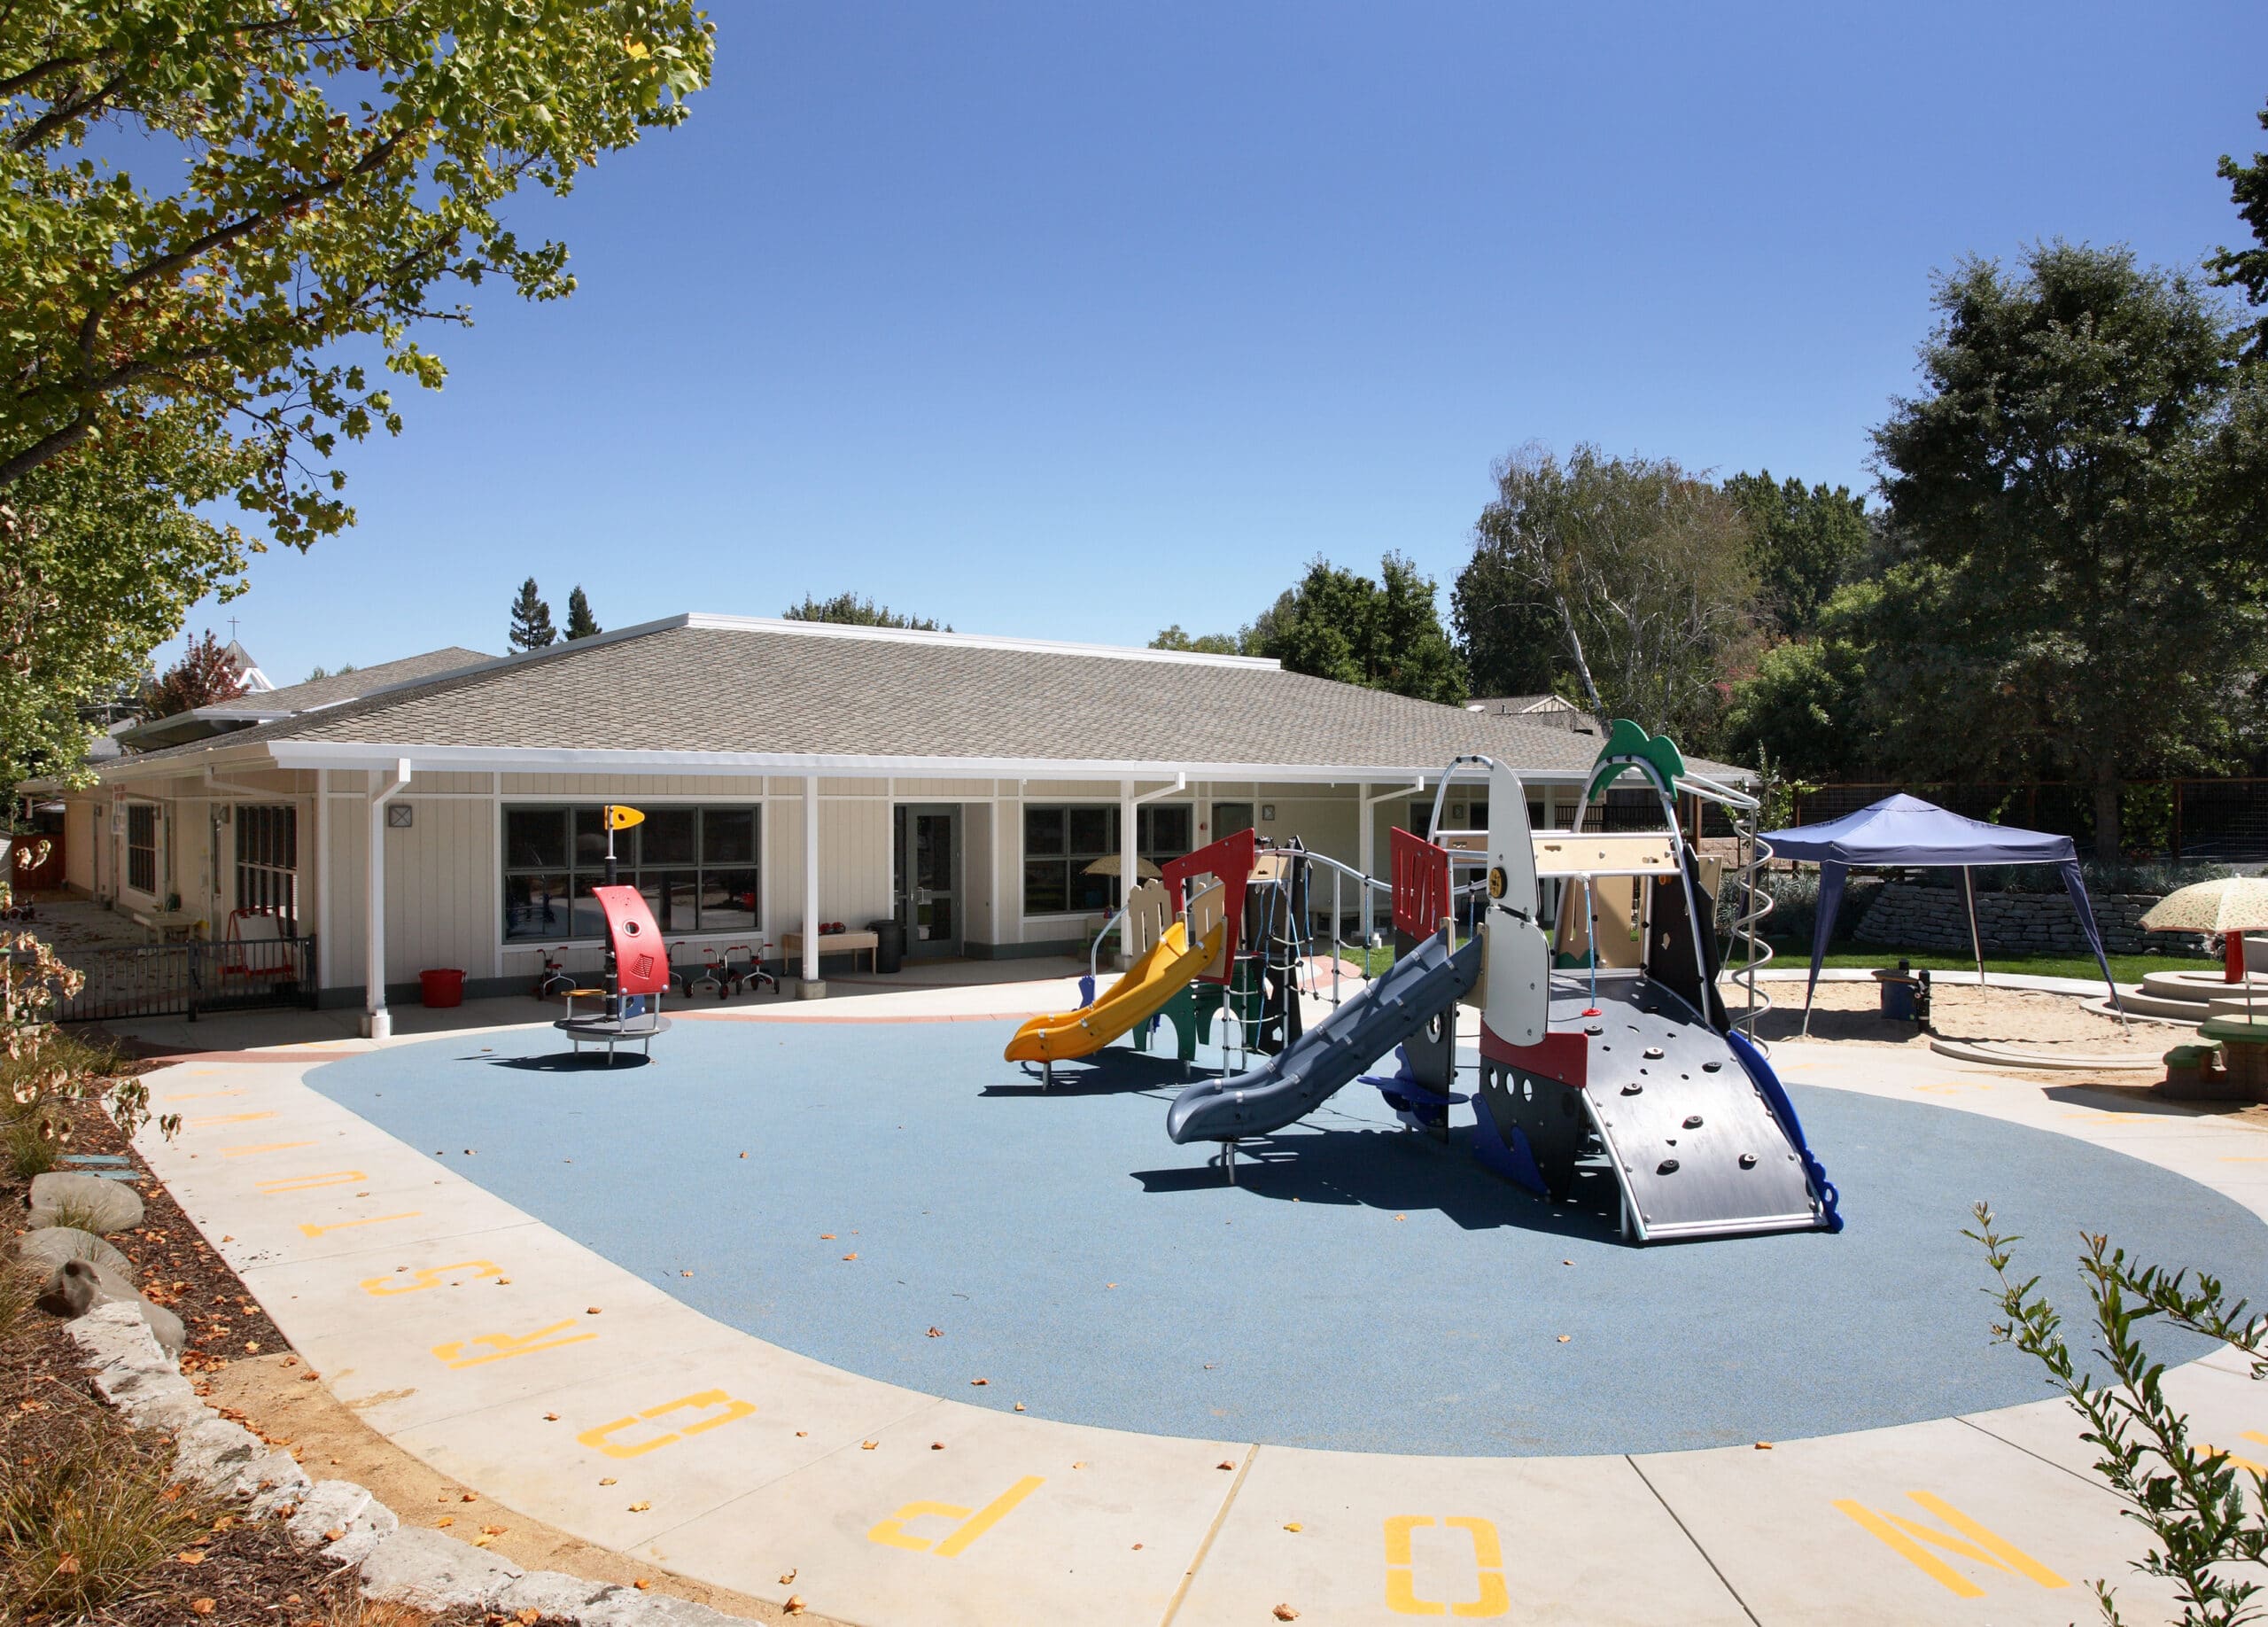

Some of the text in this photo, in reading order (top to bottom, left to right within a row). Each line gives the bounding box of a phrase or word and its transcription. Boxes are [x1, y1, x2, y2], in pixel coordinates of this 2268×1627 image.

[255, 1170, 368, 1194] U
[297, 1211, 423, 1238] T
[359, 1259, 504, 1296] S
[430, 1318, 601, 1370] R
[576, 1389, 757, 1460] Q
[866, 1475, 1047, 1559] P
[1830, 1491, 2071, 1599] N
[1384, 1515, 1511, 1618] O
